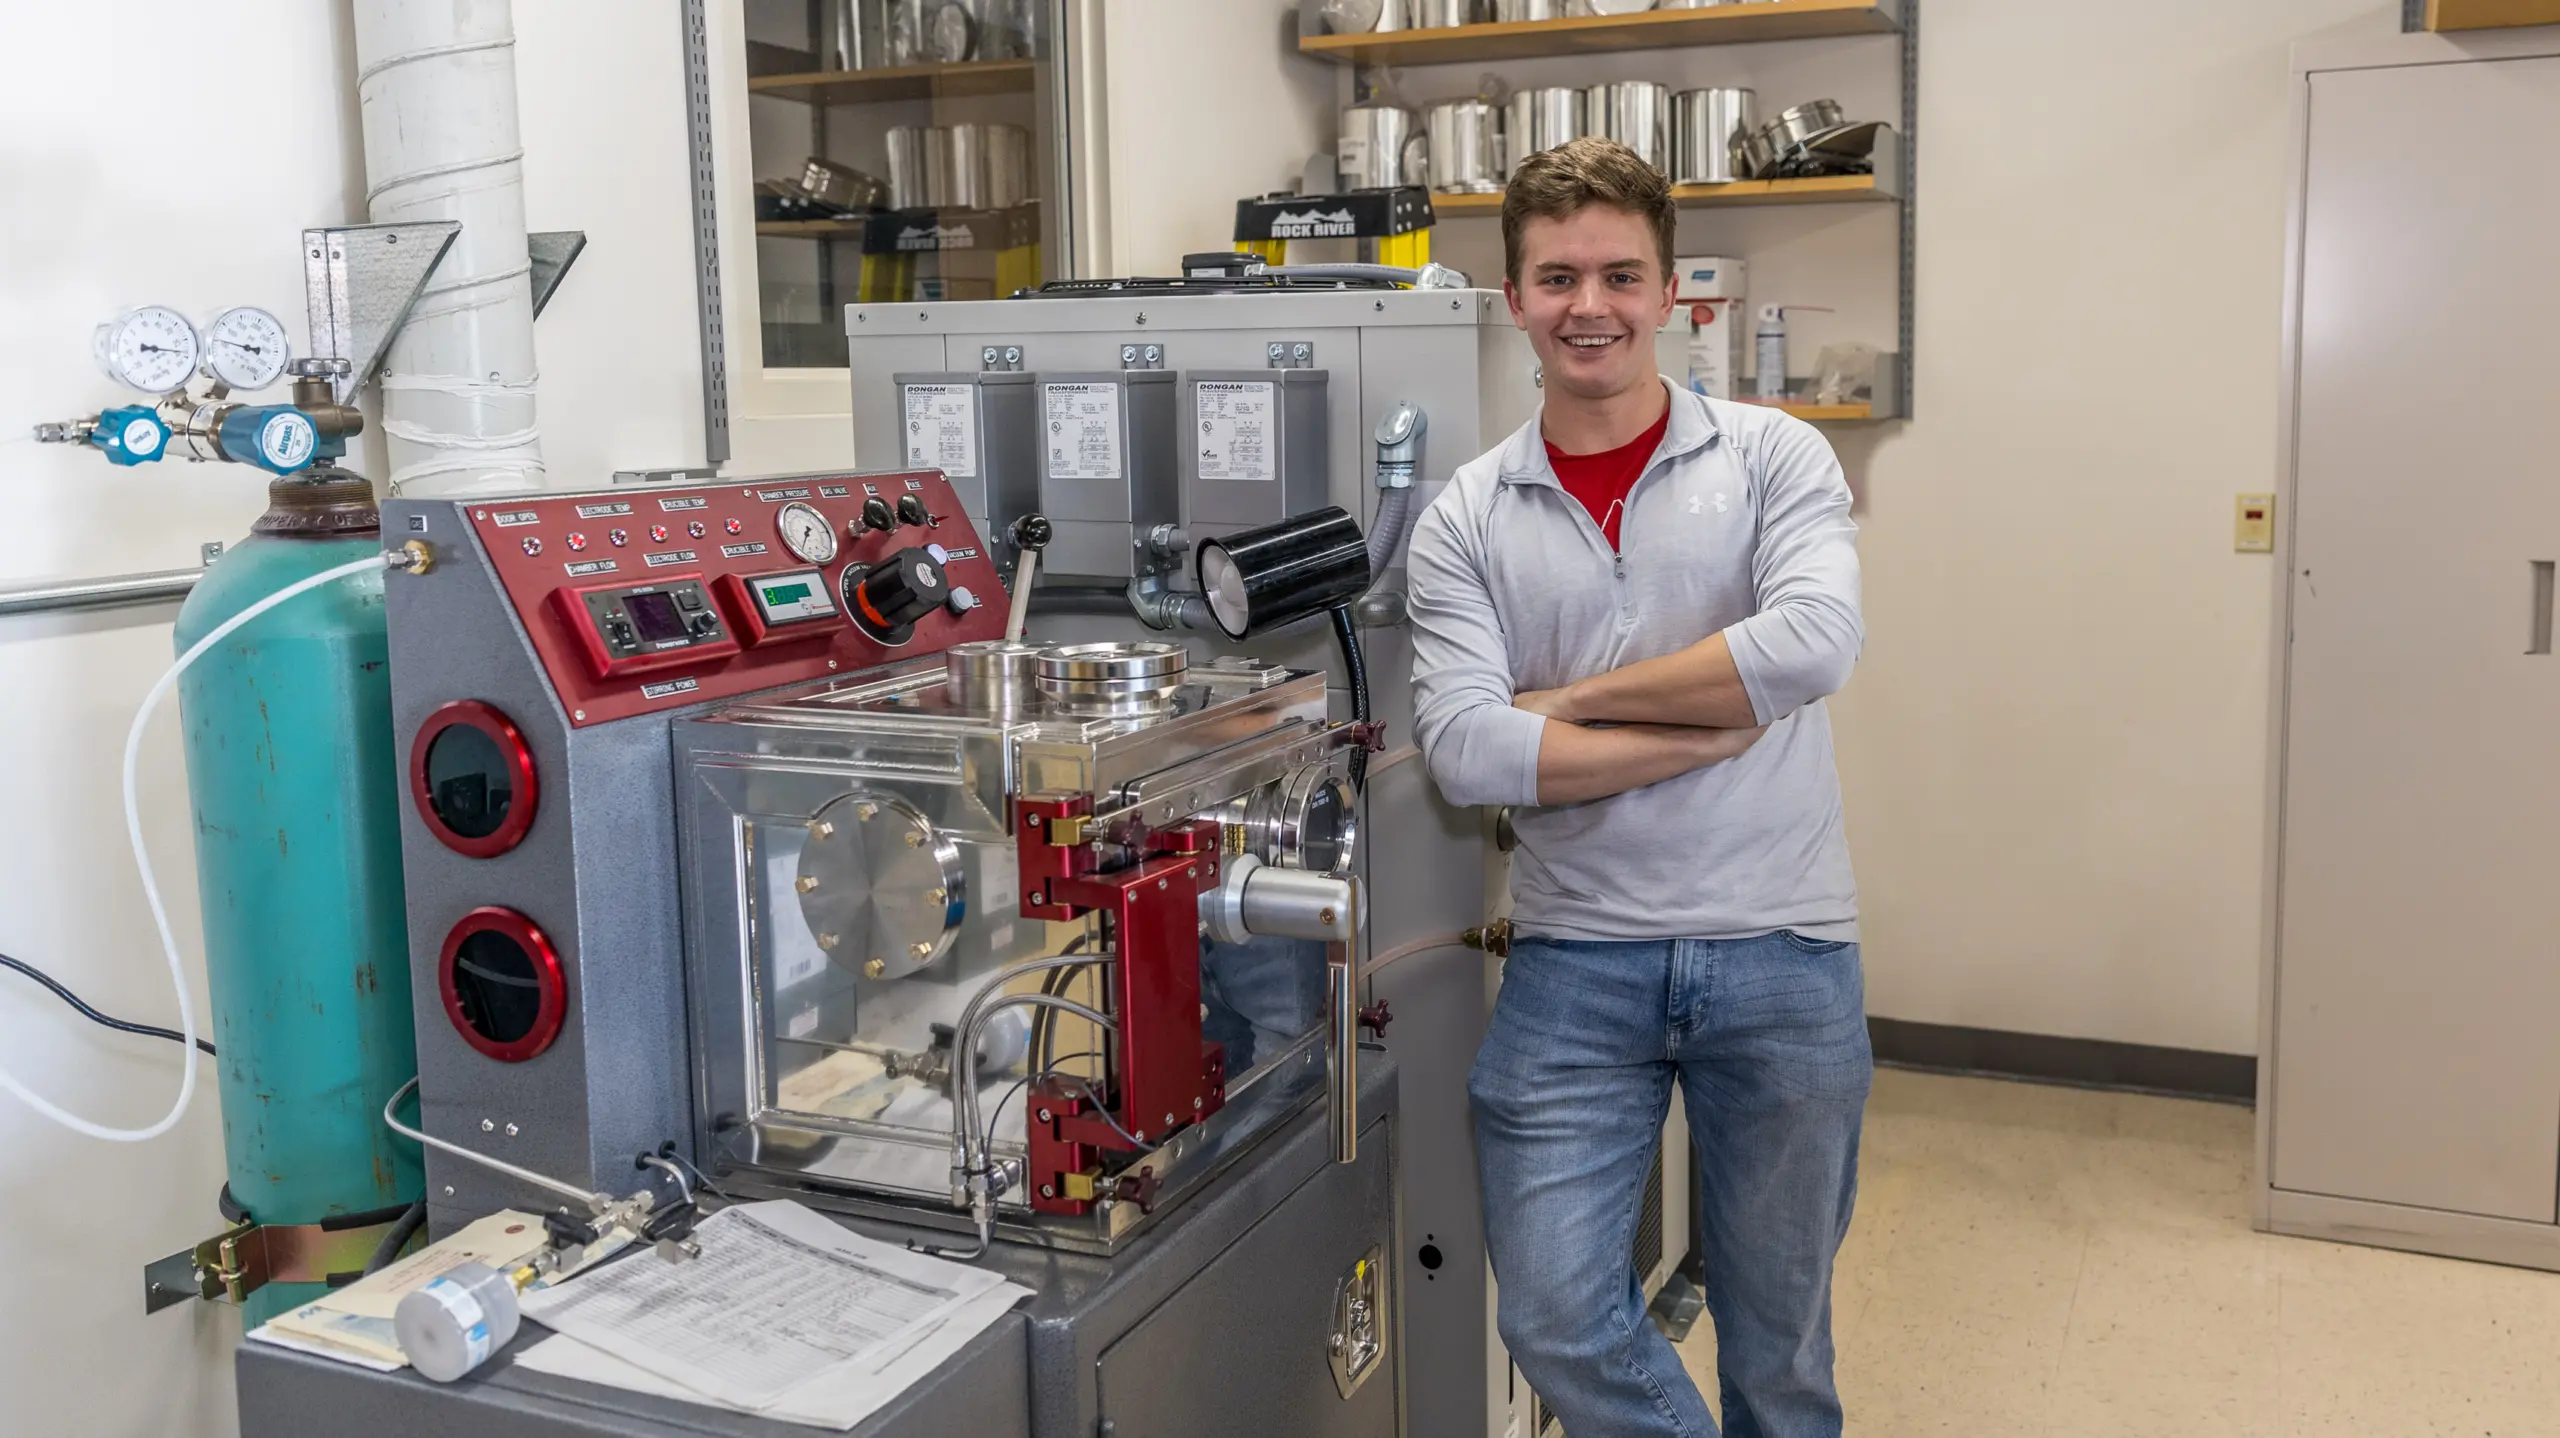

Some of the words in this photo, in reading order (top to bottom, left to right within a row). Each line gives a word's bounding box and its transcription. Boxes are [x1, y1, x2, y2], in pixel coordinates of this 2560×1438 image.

[1271, 224, 1312, 238] ROCK
[1314, 222, 1356, 236] RIVER
[278, 425, 293, 455] Airgas
[760, 492, 784, 500] CHAMBER
[785, 489, 811, 497] PRESSURE
[580, 505, 613, 516] ELECTRODE
[615, 503, 631, 512] TEMP
[663, 499, 690, 509] CRUCIBLE
[691, 498, 706, 506] TEMP
[497, 514, 516, 524] DOOR
[518, 512, 537, 521] OPEN
[724, 545, 750, 555] CRUCIBLE
[751, 543, 765, 552] FLOW
[949, 551, 965, 559] VACUUM
[964, 548, 976, 556] PUMP
[648, 553, 679, 564] ELECTRODE
[681, 551, 696, 560] FLOW
[569, 563, 598, 574] CHAMBER
[599, 560, 616, 570] FLOW
[646, 683, 675, 696] STIRRING
[675, 680, 697, 691] POWER
